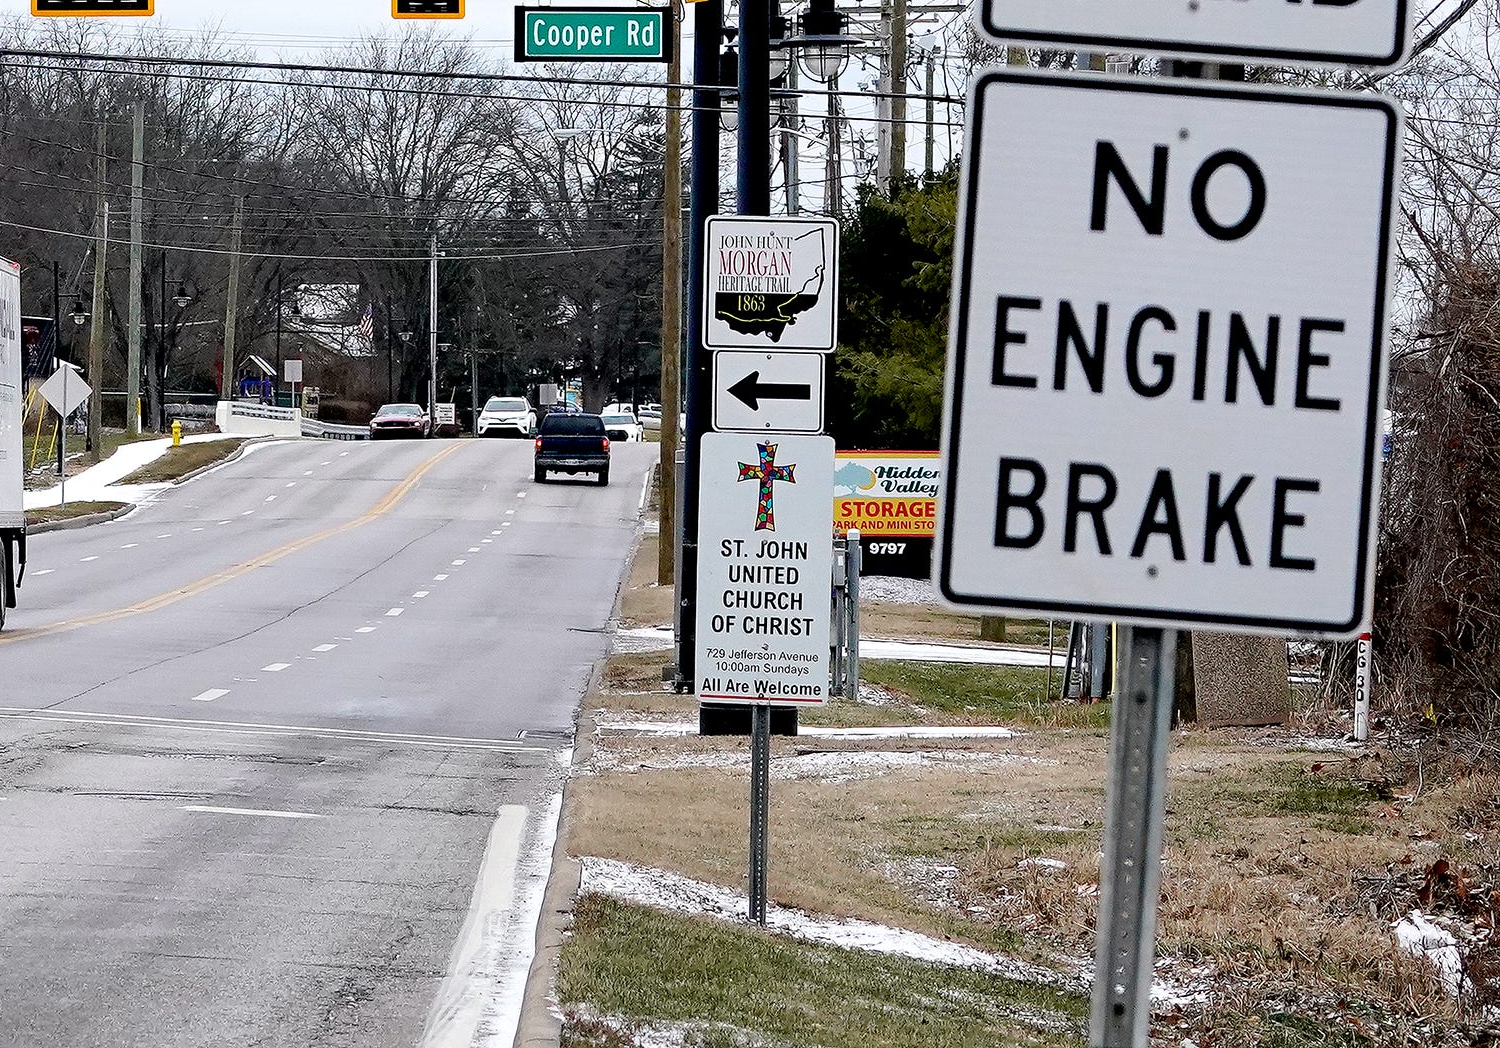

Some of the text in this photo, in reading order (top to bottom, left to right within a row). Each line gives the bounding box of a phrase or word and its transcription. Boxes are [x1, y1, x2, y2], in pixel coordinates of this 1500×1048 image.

[532, 18, 655, 51] Cooper Rd
[1089, 139, 1267, 242] NO
[718, 235, 793, 250] JOHN HUNT
[719, 249, 792, 277] MORGAN
[718, 275, 792, 293] HERITAGE TRAIL
[737, 294, 766, 312] 1863
[990, 293, 1345, 411] ENGINE
[880, 479, 940, 498] Valley
[841, 501, 936, 518] STORAGE
[993, 456, 1321, 571] BRAKE
[860, 520, 885, 530] AND
[886, 520, 912, 530] MINI
[720, 538, 808, 560] ST. JOHN
[869, 542, 907, 555] 9797
[728, 564, 800, 585] UNITED
[722, 589, 803, 611] CHURCH
[711, 614, 815, 636] OF CHRIST
[705, 647, 819, 663] 729 Jefferson Avenue
[715, 661, 810, 677] 10:00am Sundays
[701, 677, 822, 696] All Are Welcome
